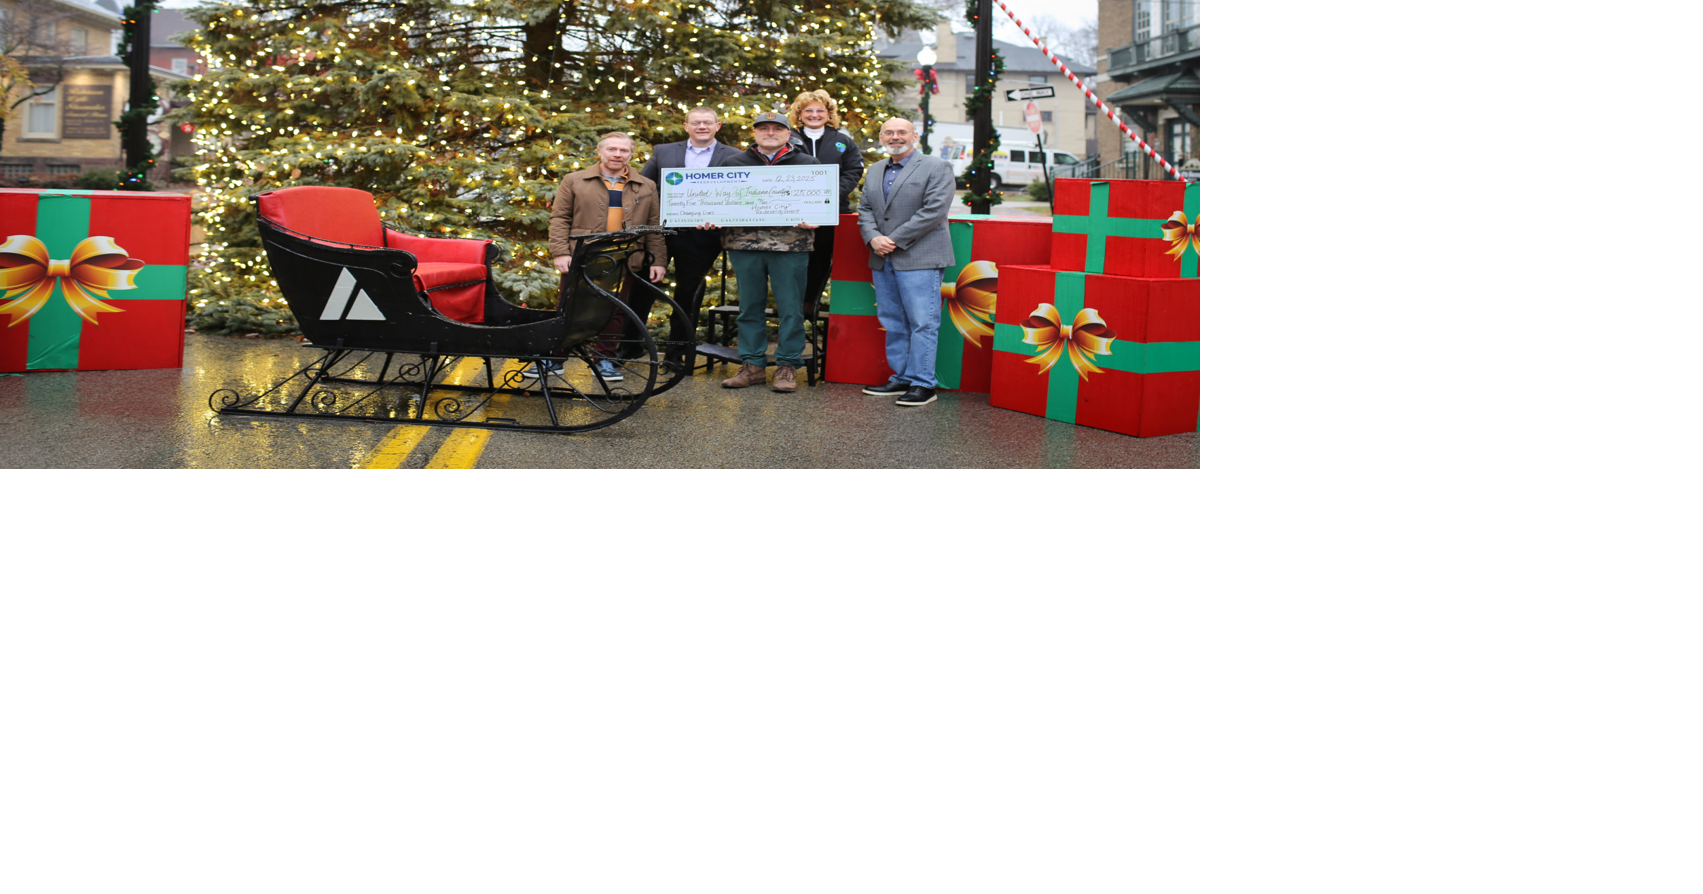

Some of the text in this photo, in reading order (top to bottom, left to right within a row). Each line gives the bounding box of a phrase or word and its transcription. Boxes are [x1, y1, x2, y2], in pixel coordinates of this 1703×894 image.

[685, 171, 751, 180] HOMER CITY
[686, 188, 712, 198] United
[715, 186, 736, 201] Way
[745, 186, 769, 197] Indiana
[667, 198, 685, 208] Twenty
[698, 198, 724, 206] Thousand
